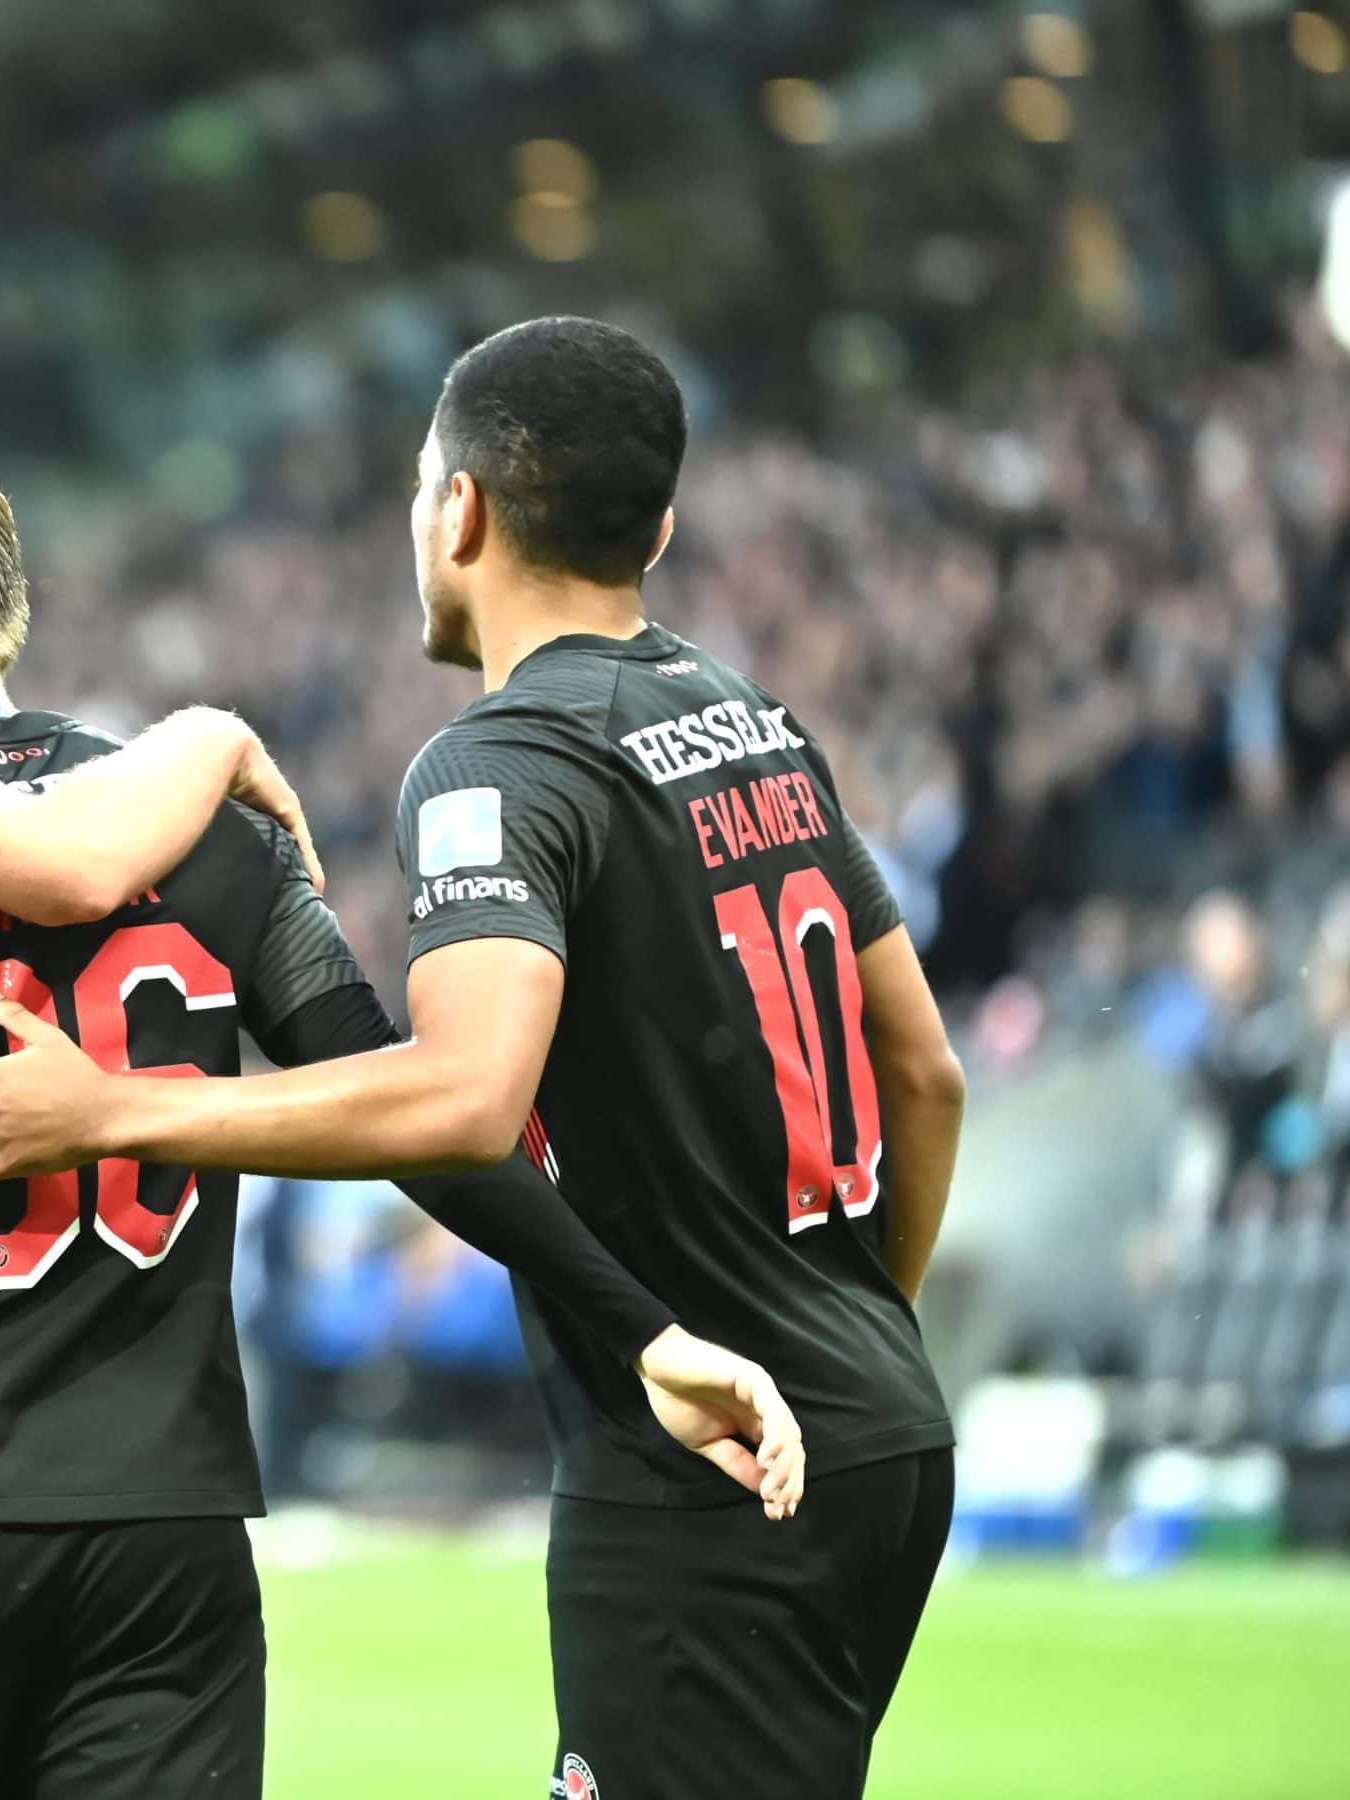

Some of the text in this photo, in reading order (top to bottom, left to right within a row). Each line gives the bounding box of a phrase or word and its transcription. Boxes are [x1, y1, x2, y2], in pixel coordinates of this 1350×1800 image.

[688, 771, 828, 869] EVANDER
[413, 876, 530, 919] al finans
[713, 866, 882, 1235] 10
